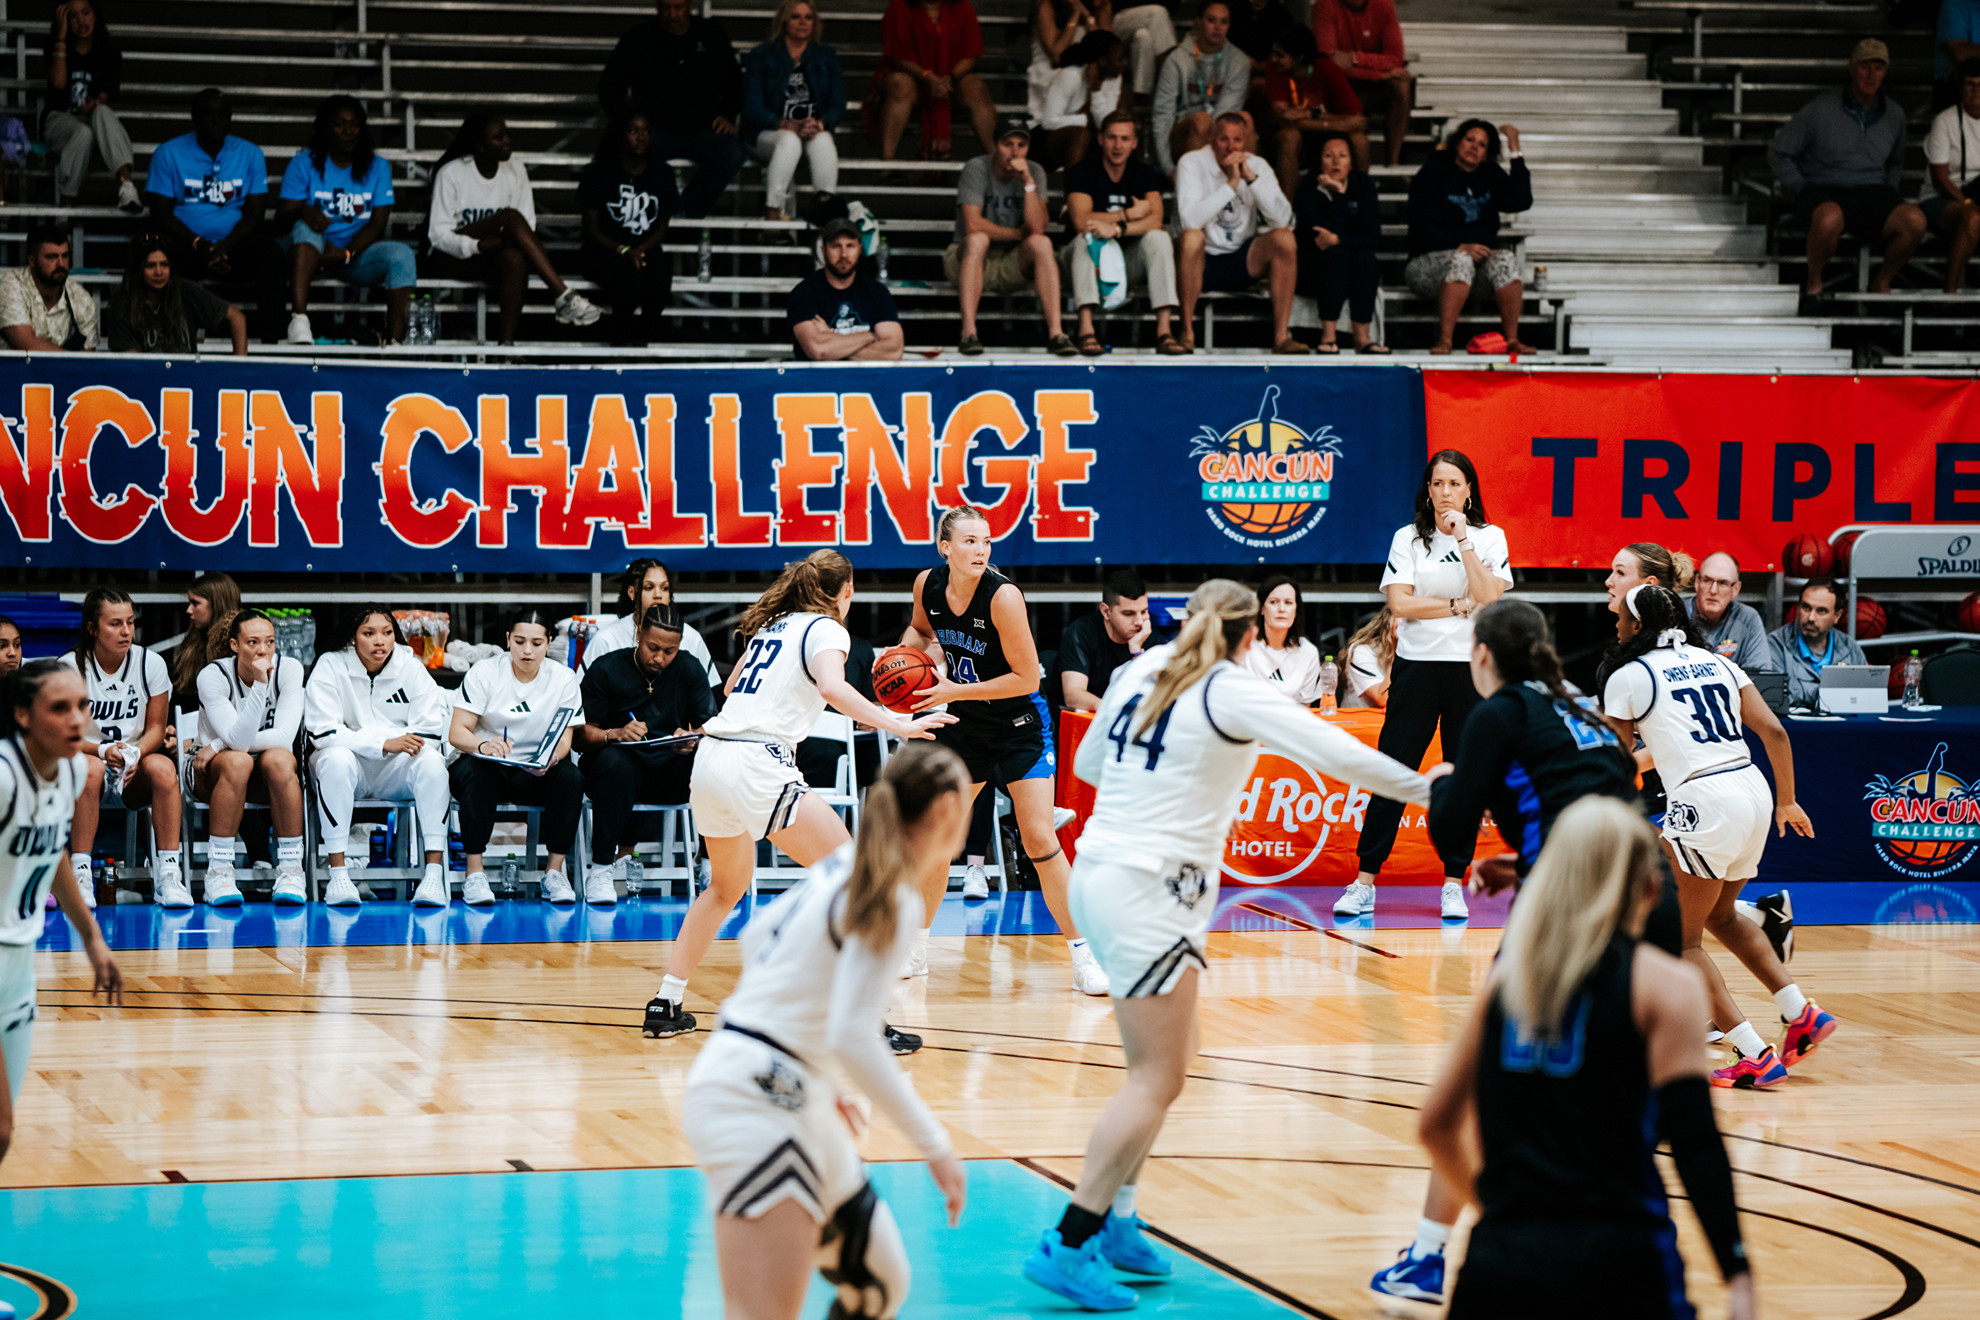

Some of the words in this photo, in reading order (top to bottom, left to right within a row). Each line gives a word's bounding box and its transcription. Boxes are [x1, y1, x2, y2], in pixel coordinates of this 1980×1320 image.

[373, 390, 1098, 550] CHALLENGE
[1199, 451, 1334, 483] CANCUN
[1531, 437, 1980, 522] TRIPLE
[1208, 485, 1322, 499] CHALLENGE
[1206, 506, 1225, 530] HARD
[1223, 527, 1246, 544] ROCK
[1246, 538, 1274, 548] HOTEL
[1275, 527, 1309, 547] RIVIERA
[1306, 506, 1327, 530] MAYA
[1917, 556, 1980, 577] SPALDI
[934, 629, 987, 656] RIGHAM
[731, 639, 783, 694] 22
[945, 651, 981, 684] 14
[878, 675, 907, 699] NCAA
[1671, 683, 1743, 744] 30
[1108, 693, 1177, 772] 44
[1266, 778, 1371, 833] Rock
[1871, 797, 1980, 824] CANCUN
[1878, 825, 1976, 838] CHALLENGE
[1231, 840, 1295, 857] HOTEL
[1874, 842, 1890, 862] HARD
[1888, 860, 1907, 874] ROCK
[1907, 870, 1932, 879] HOTEL
[1933, 862, 1963, 878] RIVIERA
[1961, 845, 1979, 863] MAYA
